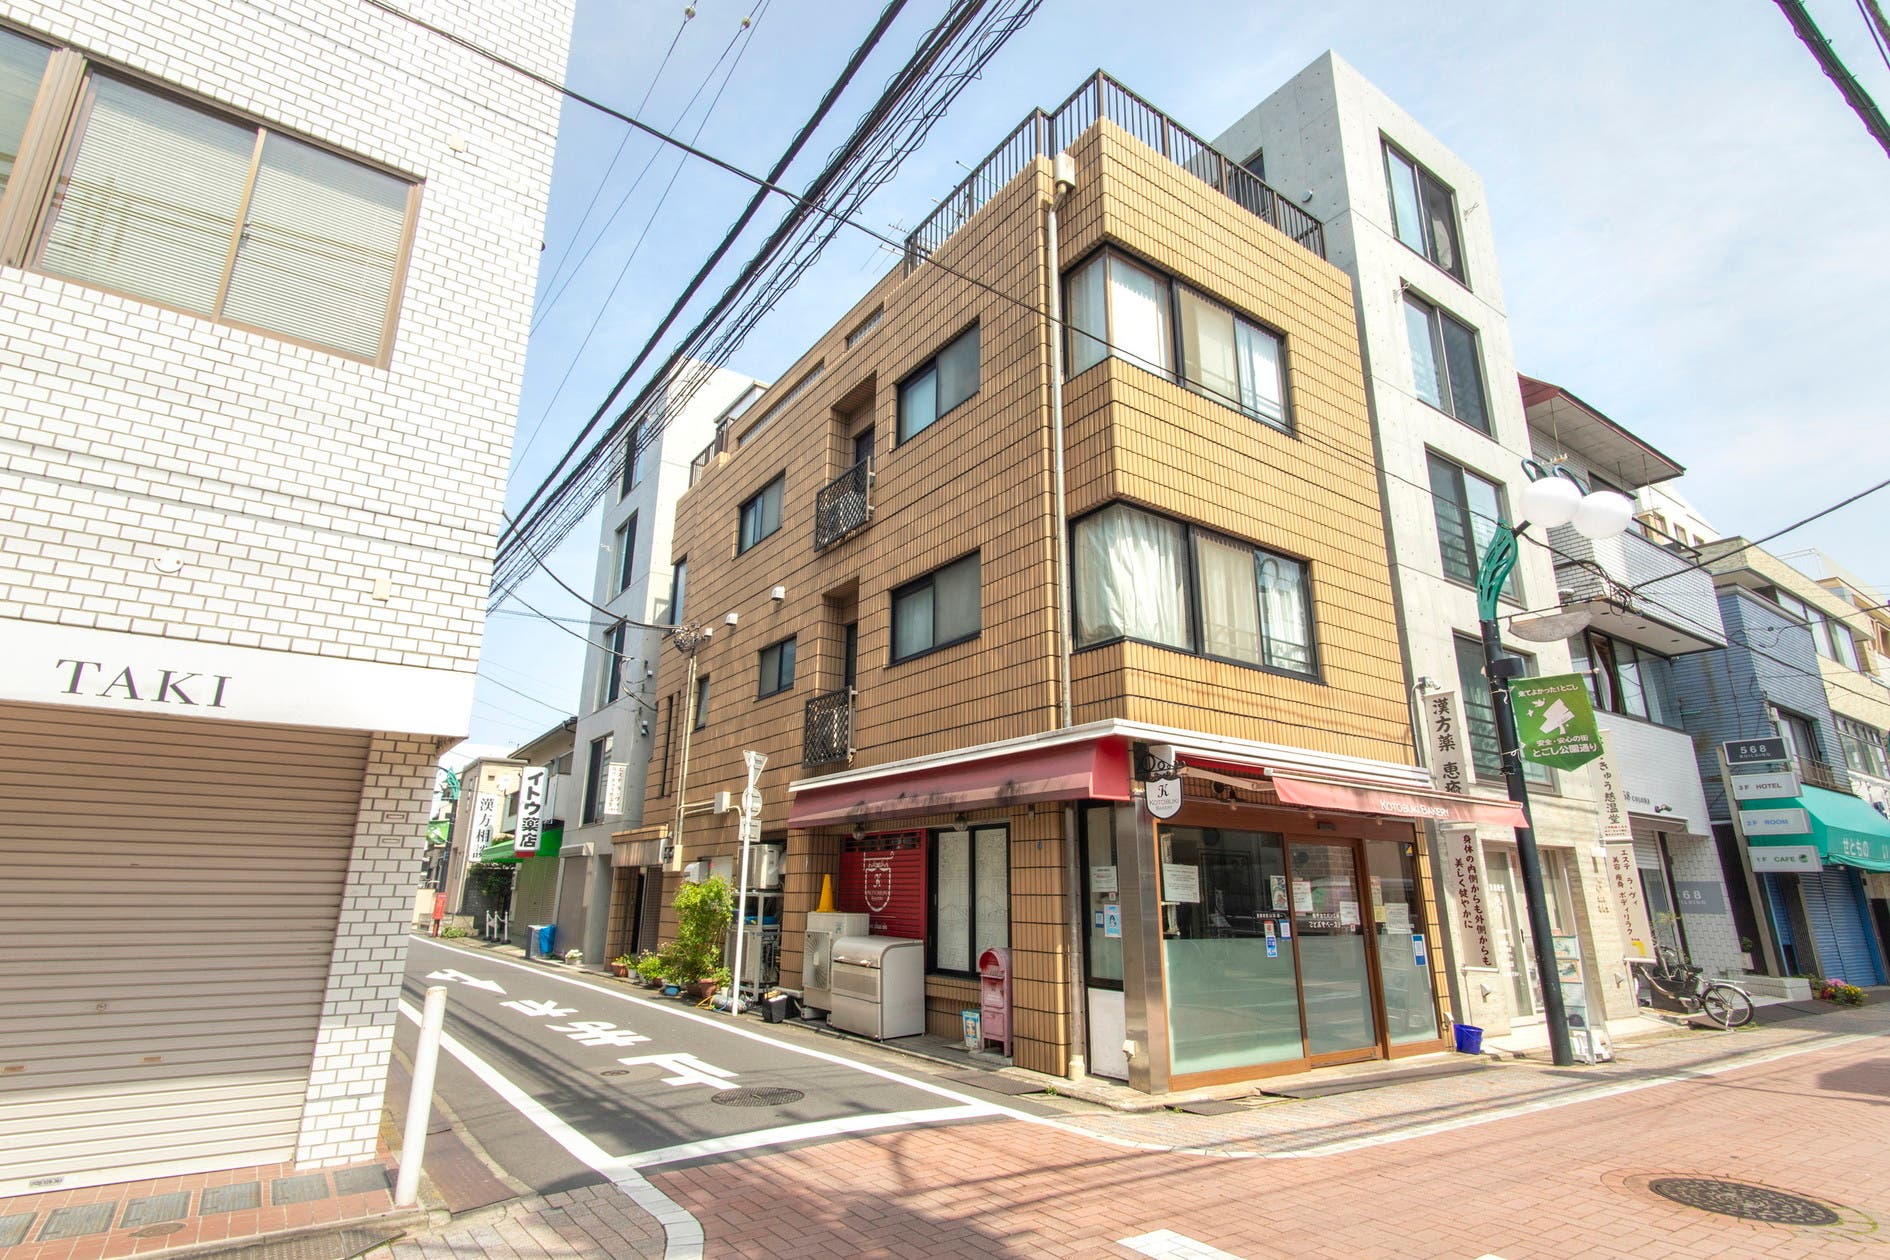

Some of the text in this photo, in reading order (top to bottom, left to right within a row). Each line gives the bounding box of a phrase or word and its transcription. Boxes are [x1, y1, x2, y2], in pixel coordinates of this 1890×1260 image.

[55, 658, 233, 709] TAKI
[1432, 697, 1456, 751] 漢方薬
[1740, 744, 1768, 754] 568
[1157, 783, 1169, 797] K
[519, 771, 544, 848] イトウ薬店
[1149, 798, 1179, 806] KOTOBUKI
[1379, 799, 1450, 817] KOTOBUKI BAKERY
[1764, 818, 1789, 826] ROOM
[1842, 837, 1870, 858] せともの
[1621, 849, 1631, 870] エステ
[1454, 857, 1474, 929] 美しく健やかに
[1463, 834, 1492, 966] 身体の内側からも外側からも
[1679, 890, 1702, 900] 68
